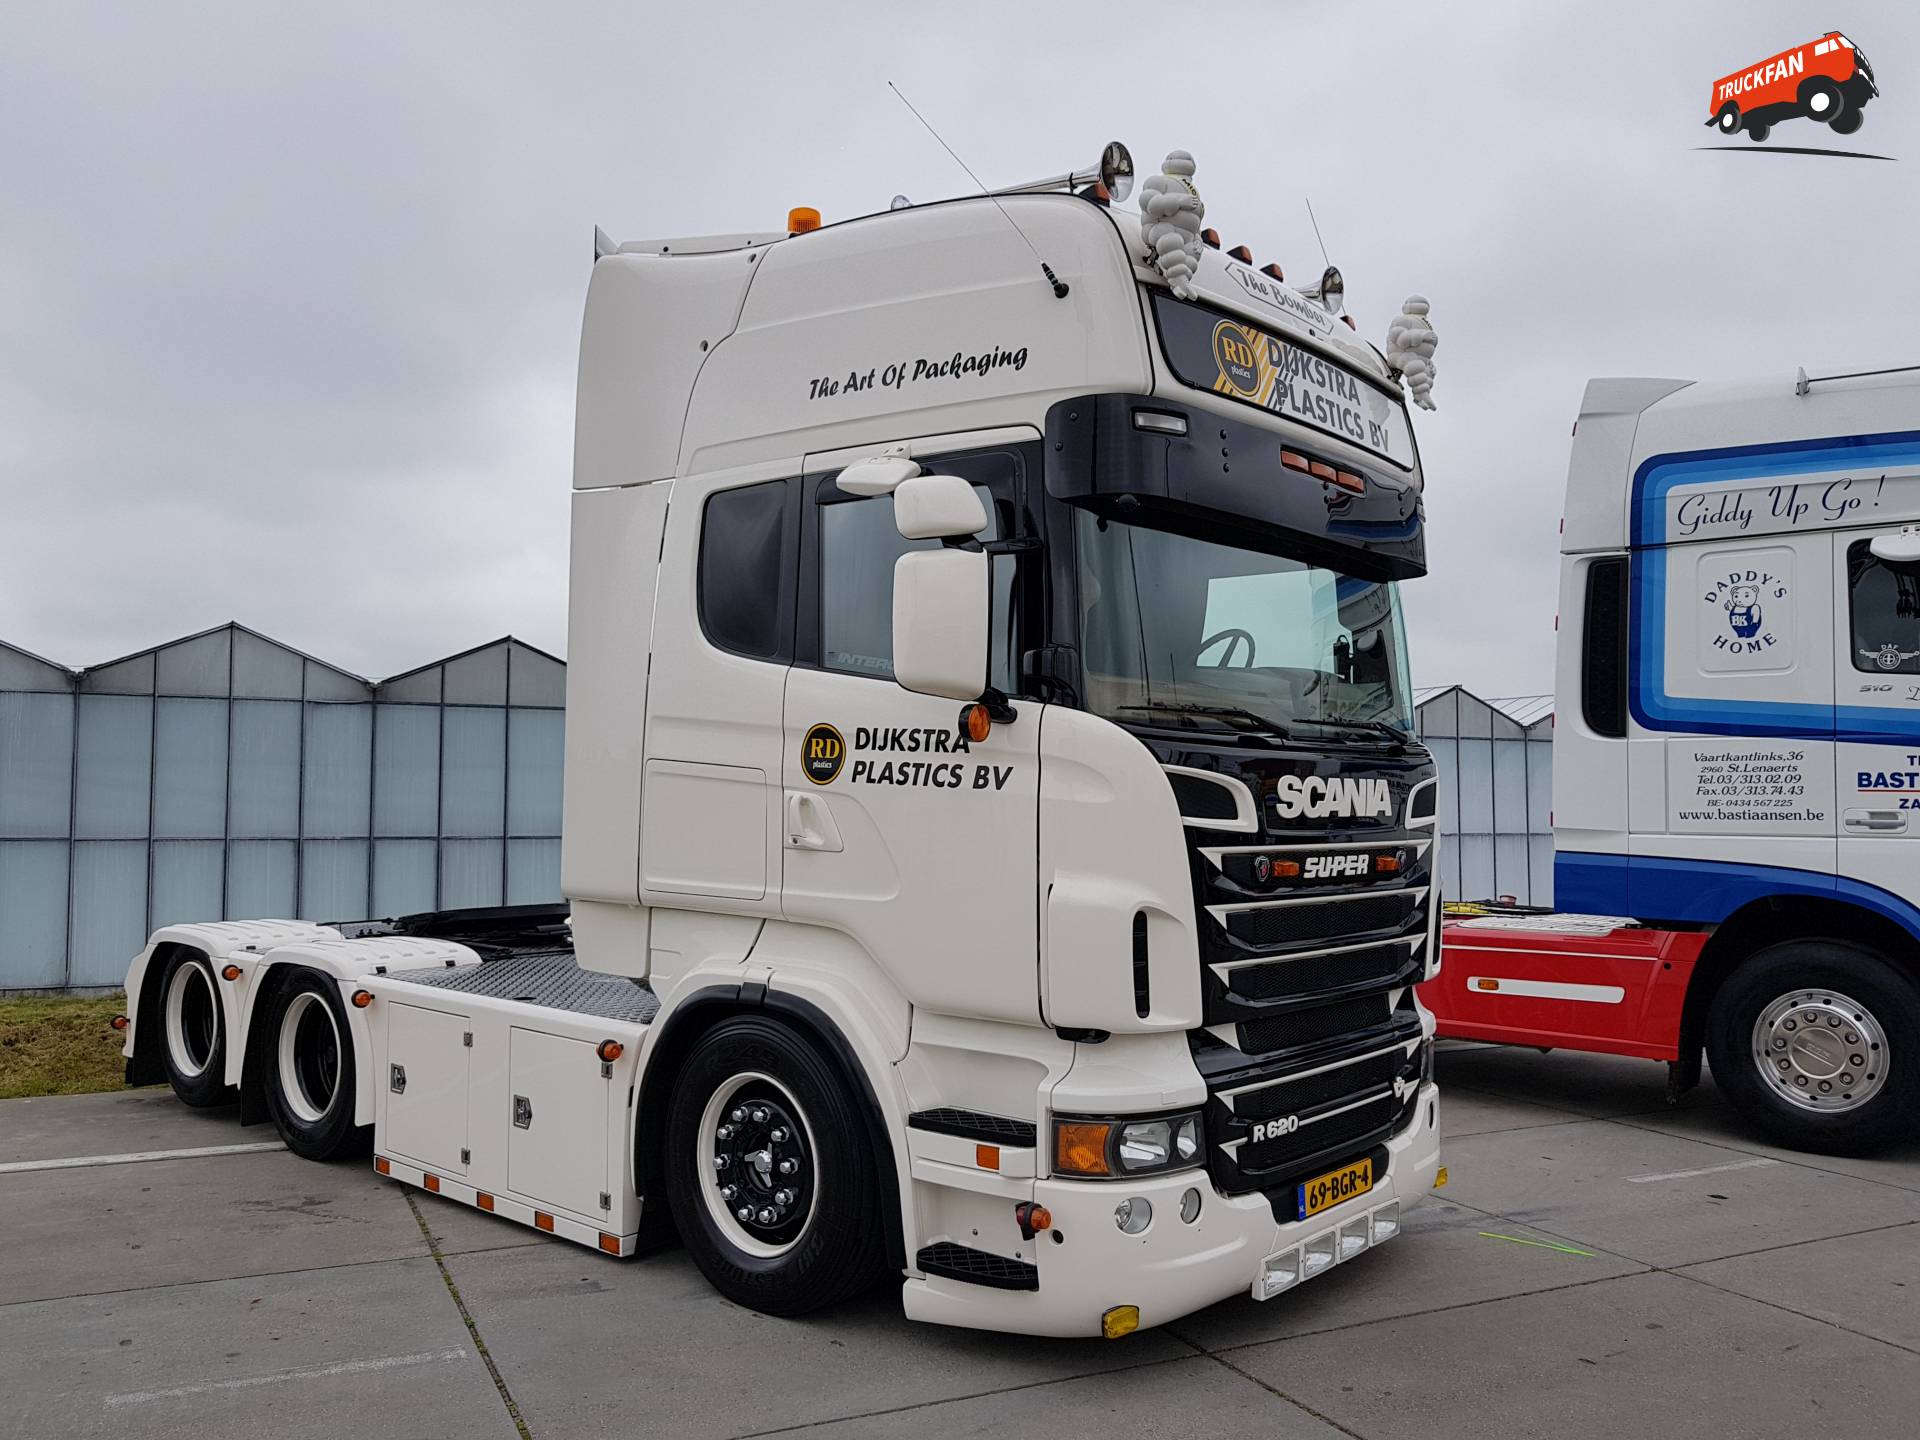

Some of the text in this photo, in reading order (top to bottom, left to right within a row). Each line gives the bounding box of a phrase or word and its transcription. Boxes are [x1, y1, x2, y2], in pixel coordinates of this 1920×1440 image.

[1236, 268, 1269, 295] The
[1221, 336, 1254, 368] RD
[809, 345, 1029, 401] The Art Of Packaging
[1266, 337, 1362, 406] DIJKSTRA
[1274, 378, 1389, 453] PLASTICS BV
[1677, 492, 1754, 536] Giddy
[1768, 484, 1809, 525] Up
[1821, 477, 1862, 521] Go
[1704, 570, 1787, 603] DADDY'S
[1730, 615, 1748, 627] BK
[1713, 632, 1777, 655] HOME
[809, 738, 841, 759] RD
[854, 727, 971, 754] DIJKSTRA
[812, 759, 833, 770] plastics
[851, 760, 1014, 791] PLASTICS BV
[1700, 766, 1723, 774] 2960
[1276, 774, 1393, 819] SCANIA
[1679, 808, 1825, 821] www.bastiaansen.be
[1302, 854, 1369, 879] SUPER
[1253, 1115, 1299, 1143] R 620
[1309, 1164, 1370, 1210] 69-BGR-4
